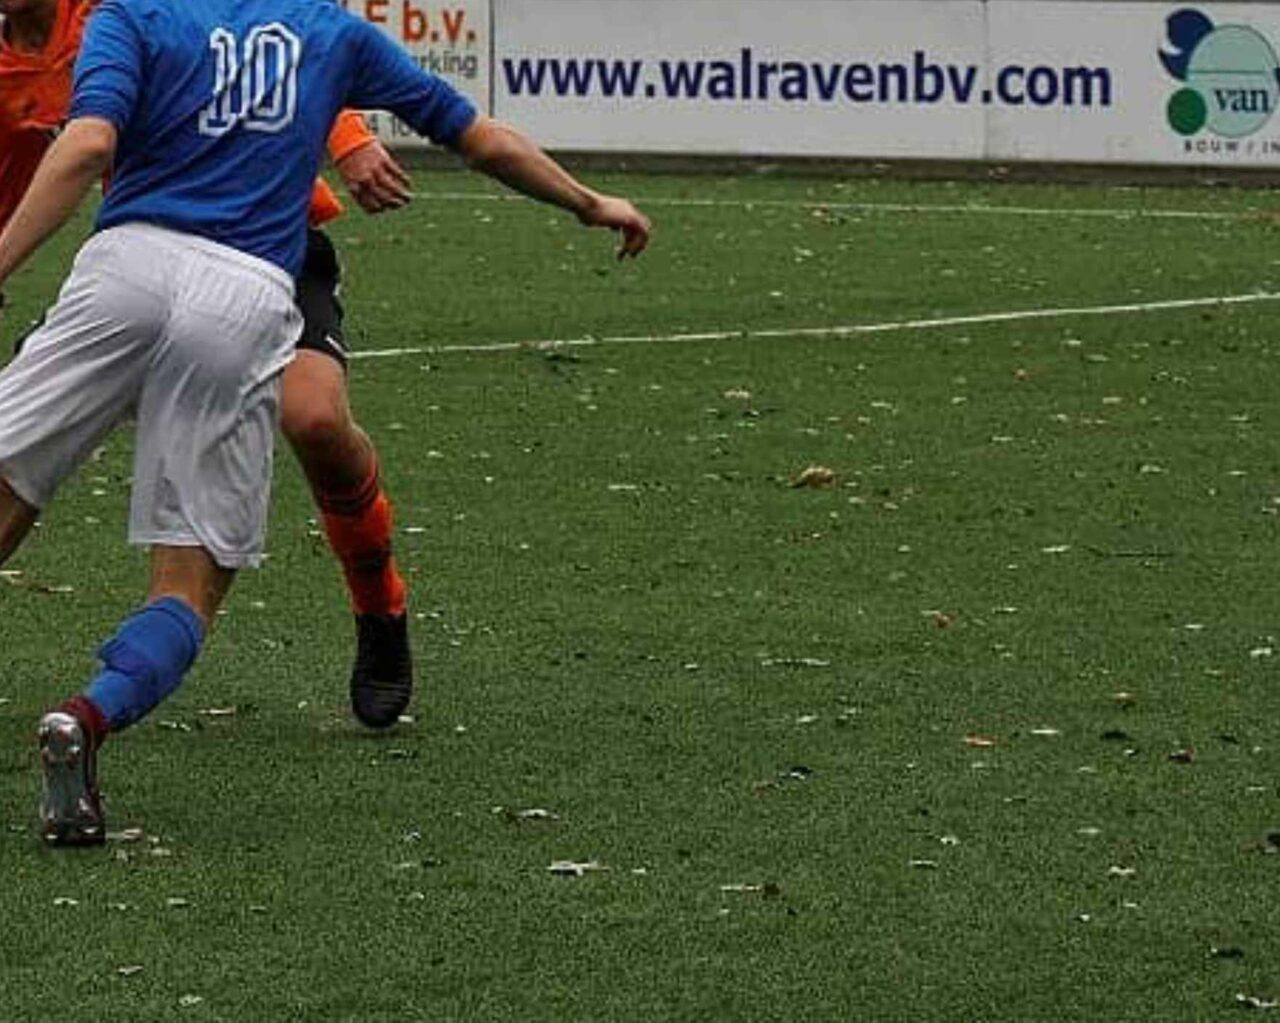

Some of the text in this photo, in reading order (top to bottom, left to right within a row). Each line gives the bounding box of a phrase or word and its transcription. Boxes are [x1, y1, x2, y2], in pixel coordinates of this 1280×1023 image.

[403, 0, 476, 41] b.v.
[199, 22, 300, 136] 10
[414, 50, 478, 78] rking
[503, 48, 1112, 107] www.walravenbv.com
[1213, 89, 1269, 113] van
